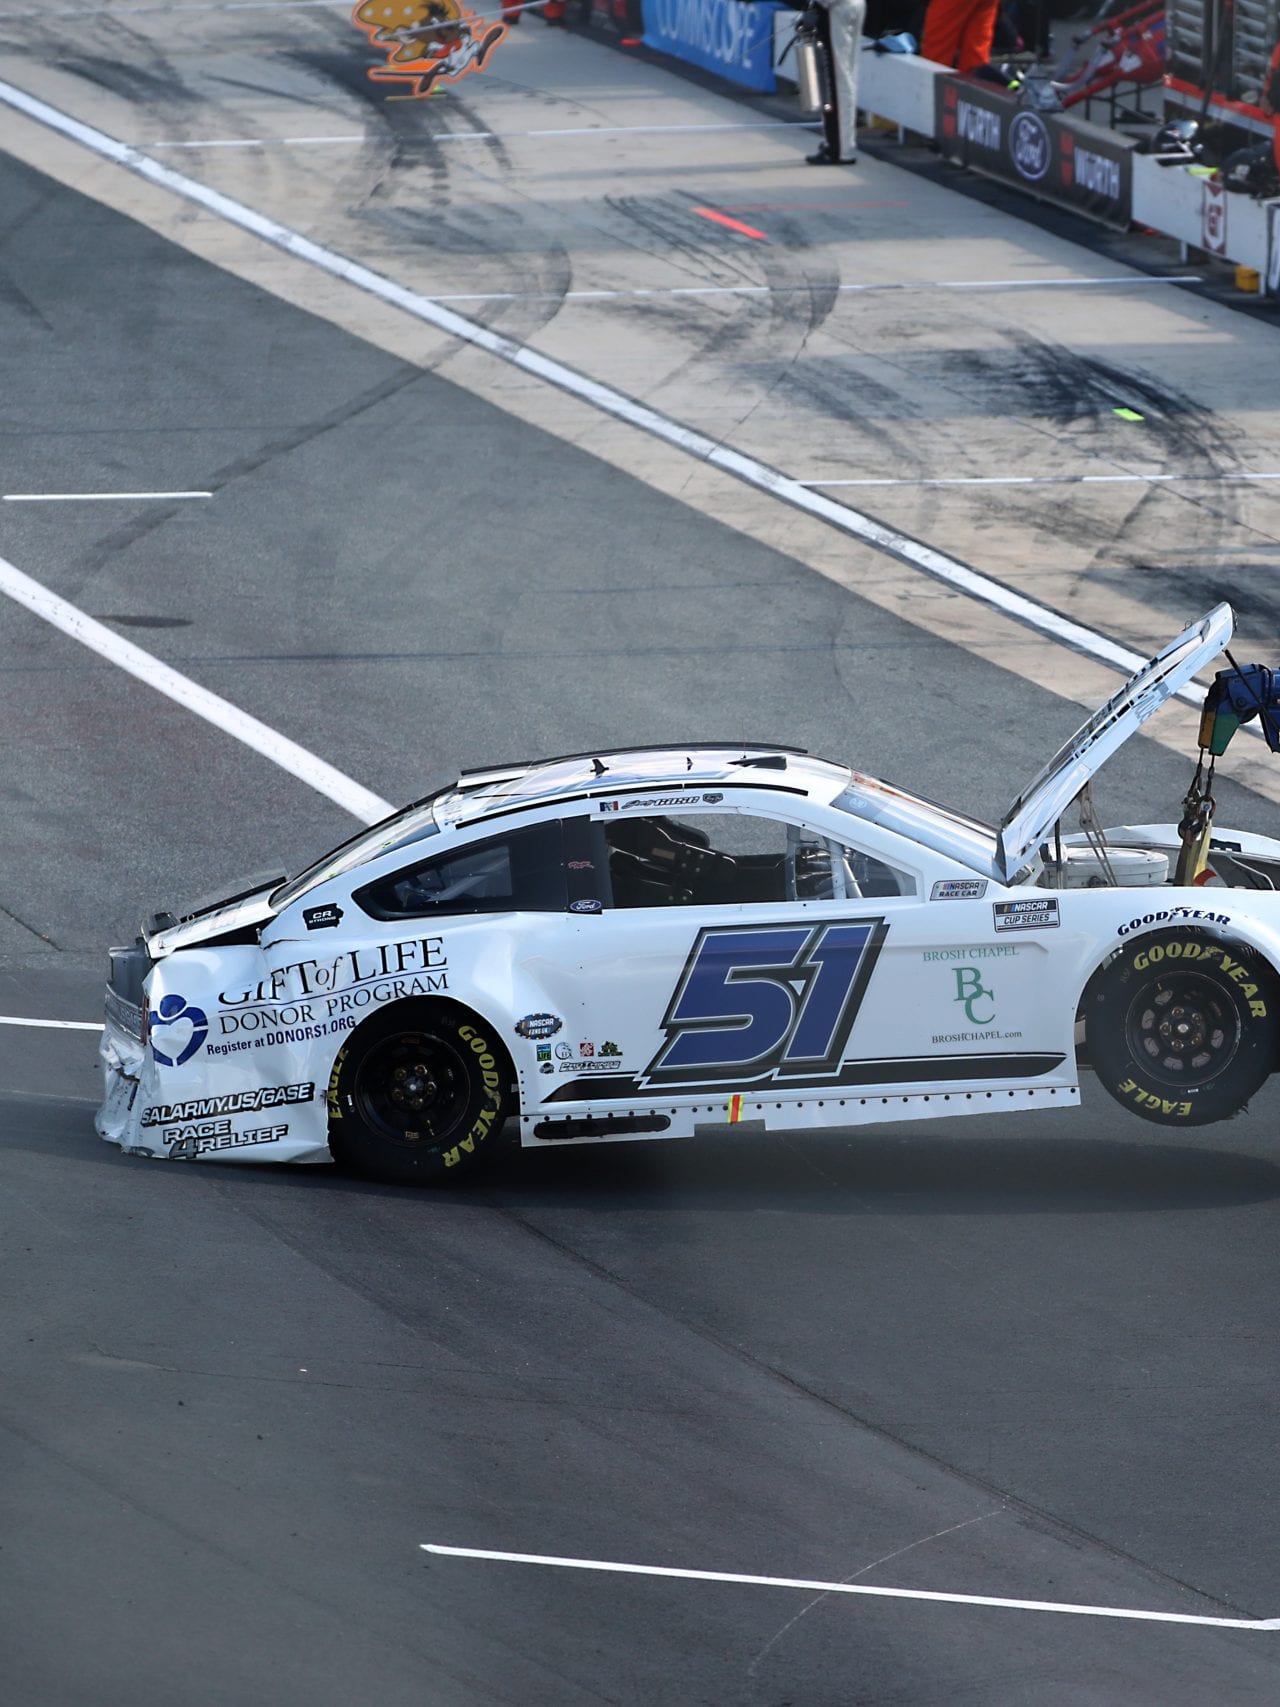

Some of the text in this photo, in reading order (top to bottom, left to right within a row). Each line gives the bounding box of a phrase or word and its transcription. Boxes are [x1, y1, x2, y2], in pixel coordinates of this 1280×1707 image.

[950, 882, 979, 890] NASCAR
[312, 910, 332, 919] CR
[1004, 913, 1050, 924] CUP SERIES
[1015, 901, 1048, 912] NASCAR
[1117, 907, 1231, 936] GOODYEAR
[315, 956, 343, 991] of
[346, 936, 448, 984] LIFE
[923, 945, 1020, 962] BROSH CHAPEL
[1133, 942, 1267, 1018] GOODYEAR
[220, 972, 449, 1035] DONOR PROGRAM
[637, 915, 891, 1091] 51
[207, 1014, 357, 1055] Register at DONORS1.ORG
[529, 1018, 554, 1027] NASCAR
[327, 1048, 350, 1119] EAGLE
[442, 1024, 502, 1168] GOODYEAR
[1118, 1078, 1193, 1116] EAGLE
[164, 1120, 231, 1143] RACE
